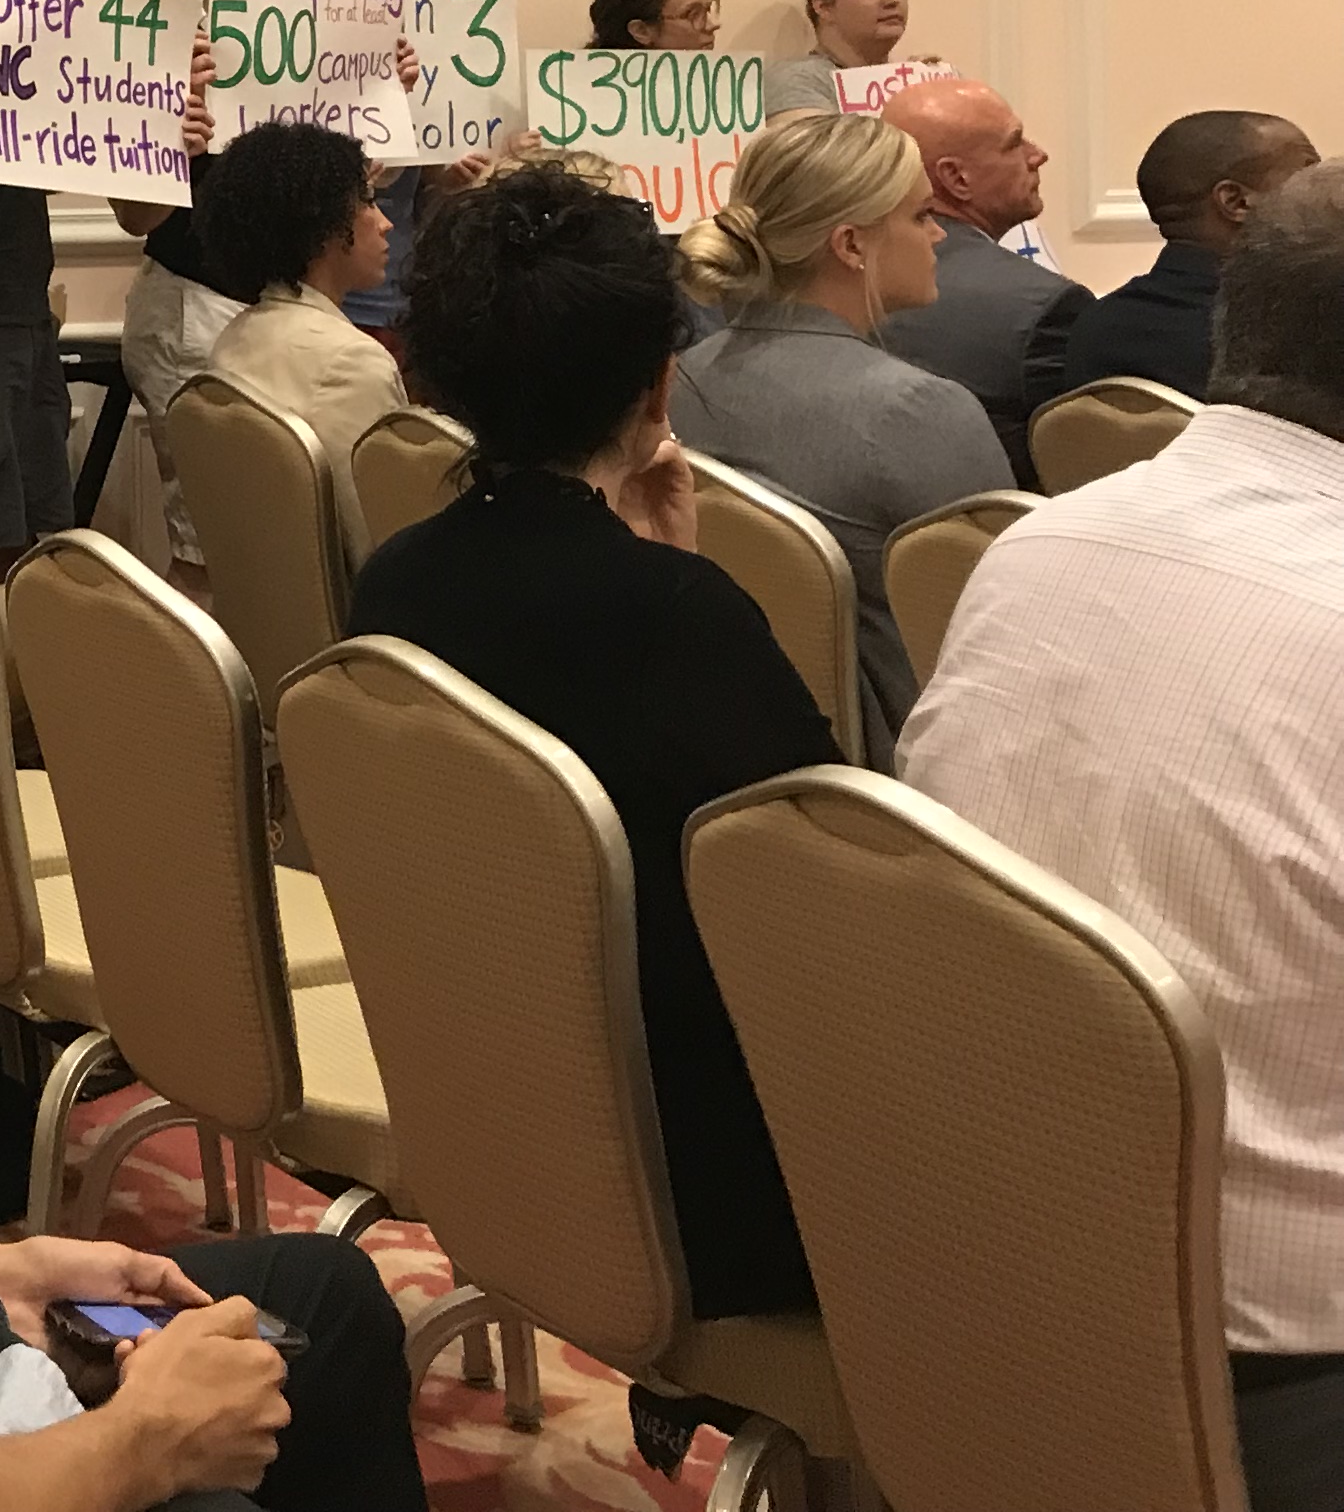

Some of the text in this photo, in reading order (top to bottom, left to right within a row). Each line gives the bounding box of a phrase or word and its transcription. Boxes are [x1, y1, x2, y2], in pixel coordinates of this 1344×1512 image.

[211, 0, 316, 89] 500
[413, 100, 503, 149] olor
[538, 49, 764, 149] $390,000
[104, 117, 189, 183] tuition
